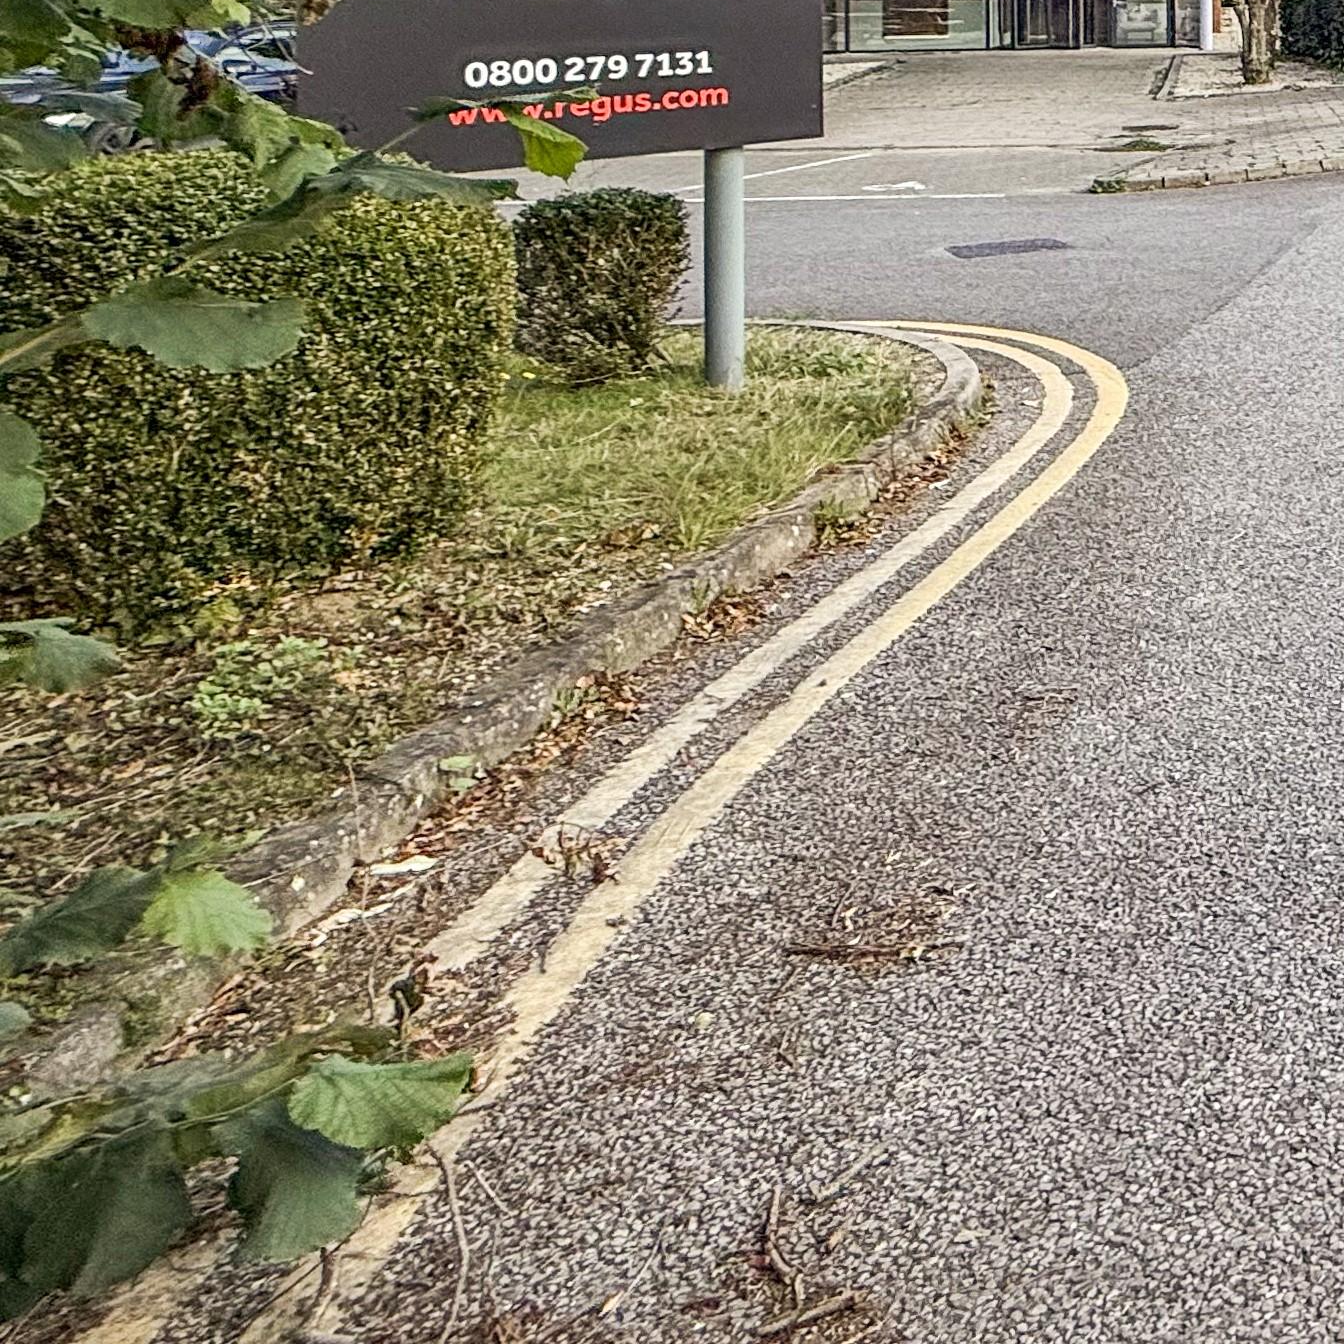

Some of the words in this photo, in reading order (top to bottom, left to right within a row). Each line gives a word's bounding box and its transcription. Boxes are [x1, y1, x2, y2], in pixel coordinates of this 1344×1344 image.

[464, 57, 558, 88] 0800
[563, 54, 629, 82] 279
[634, 50, 714, 78] 7131
